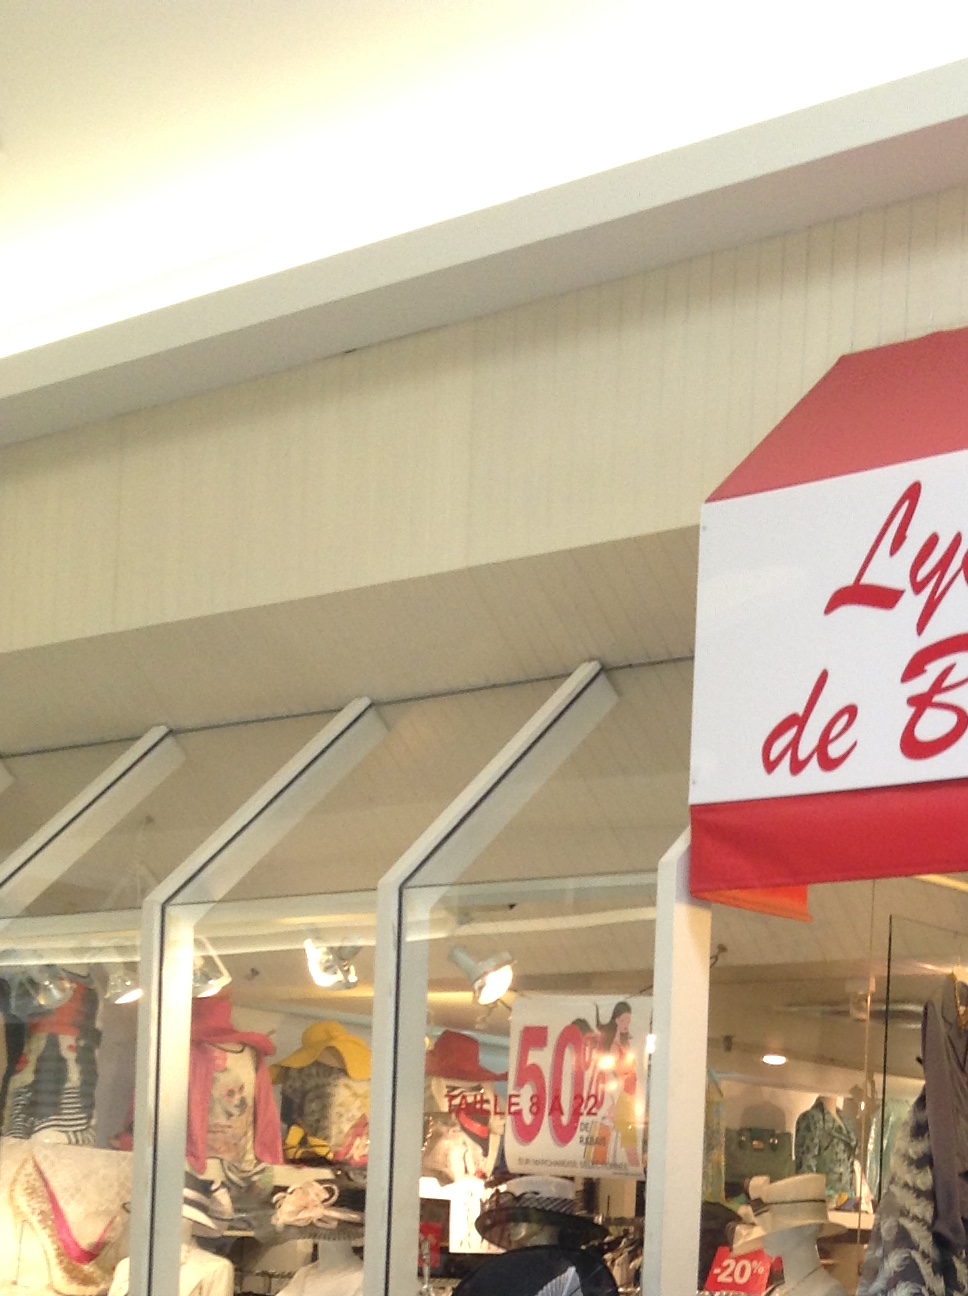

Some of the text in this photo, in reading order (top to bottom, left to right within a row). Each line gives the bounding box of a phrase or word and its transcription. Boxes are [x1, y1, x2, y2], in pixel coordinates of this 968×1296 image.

[761, 669, 858, 777] de
[573, 1094, 598, 1117] 22
[713, 1259, 764, 1286] -20%
